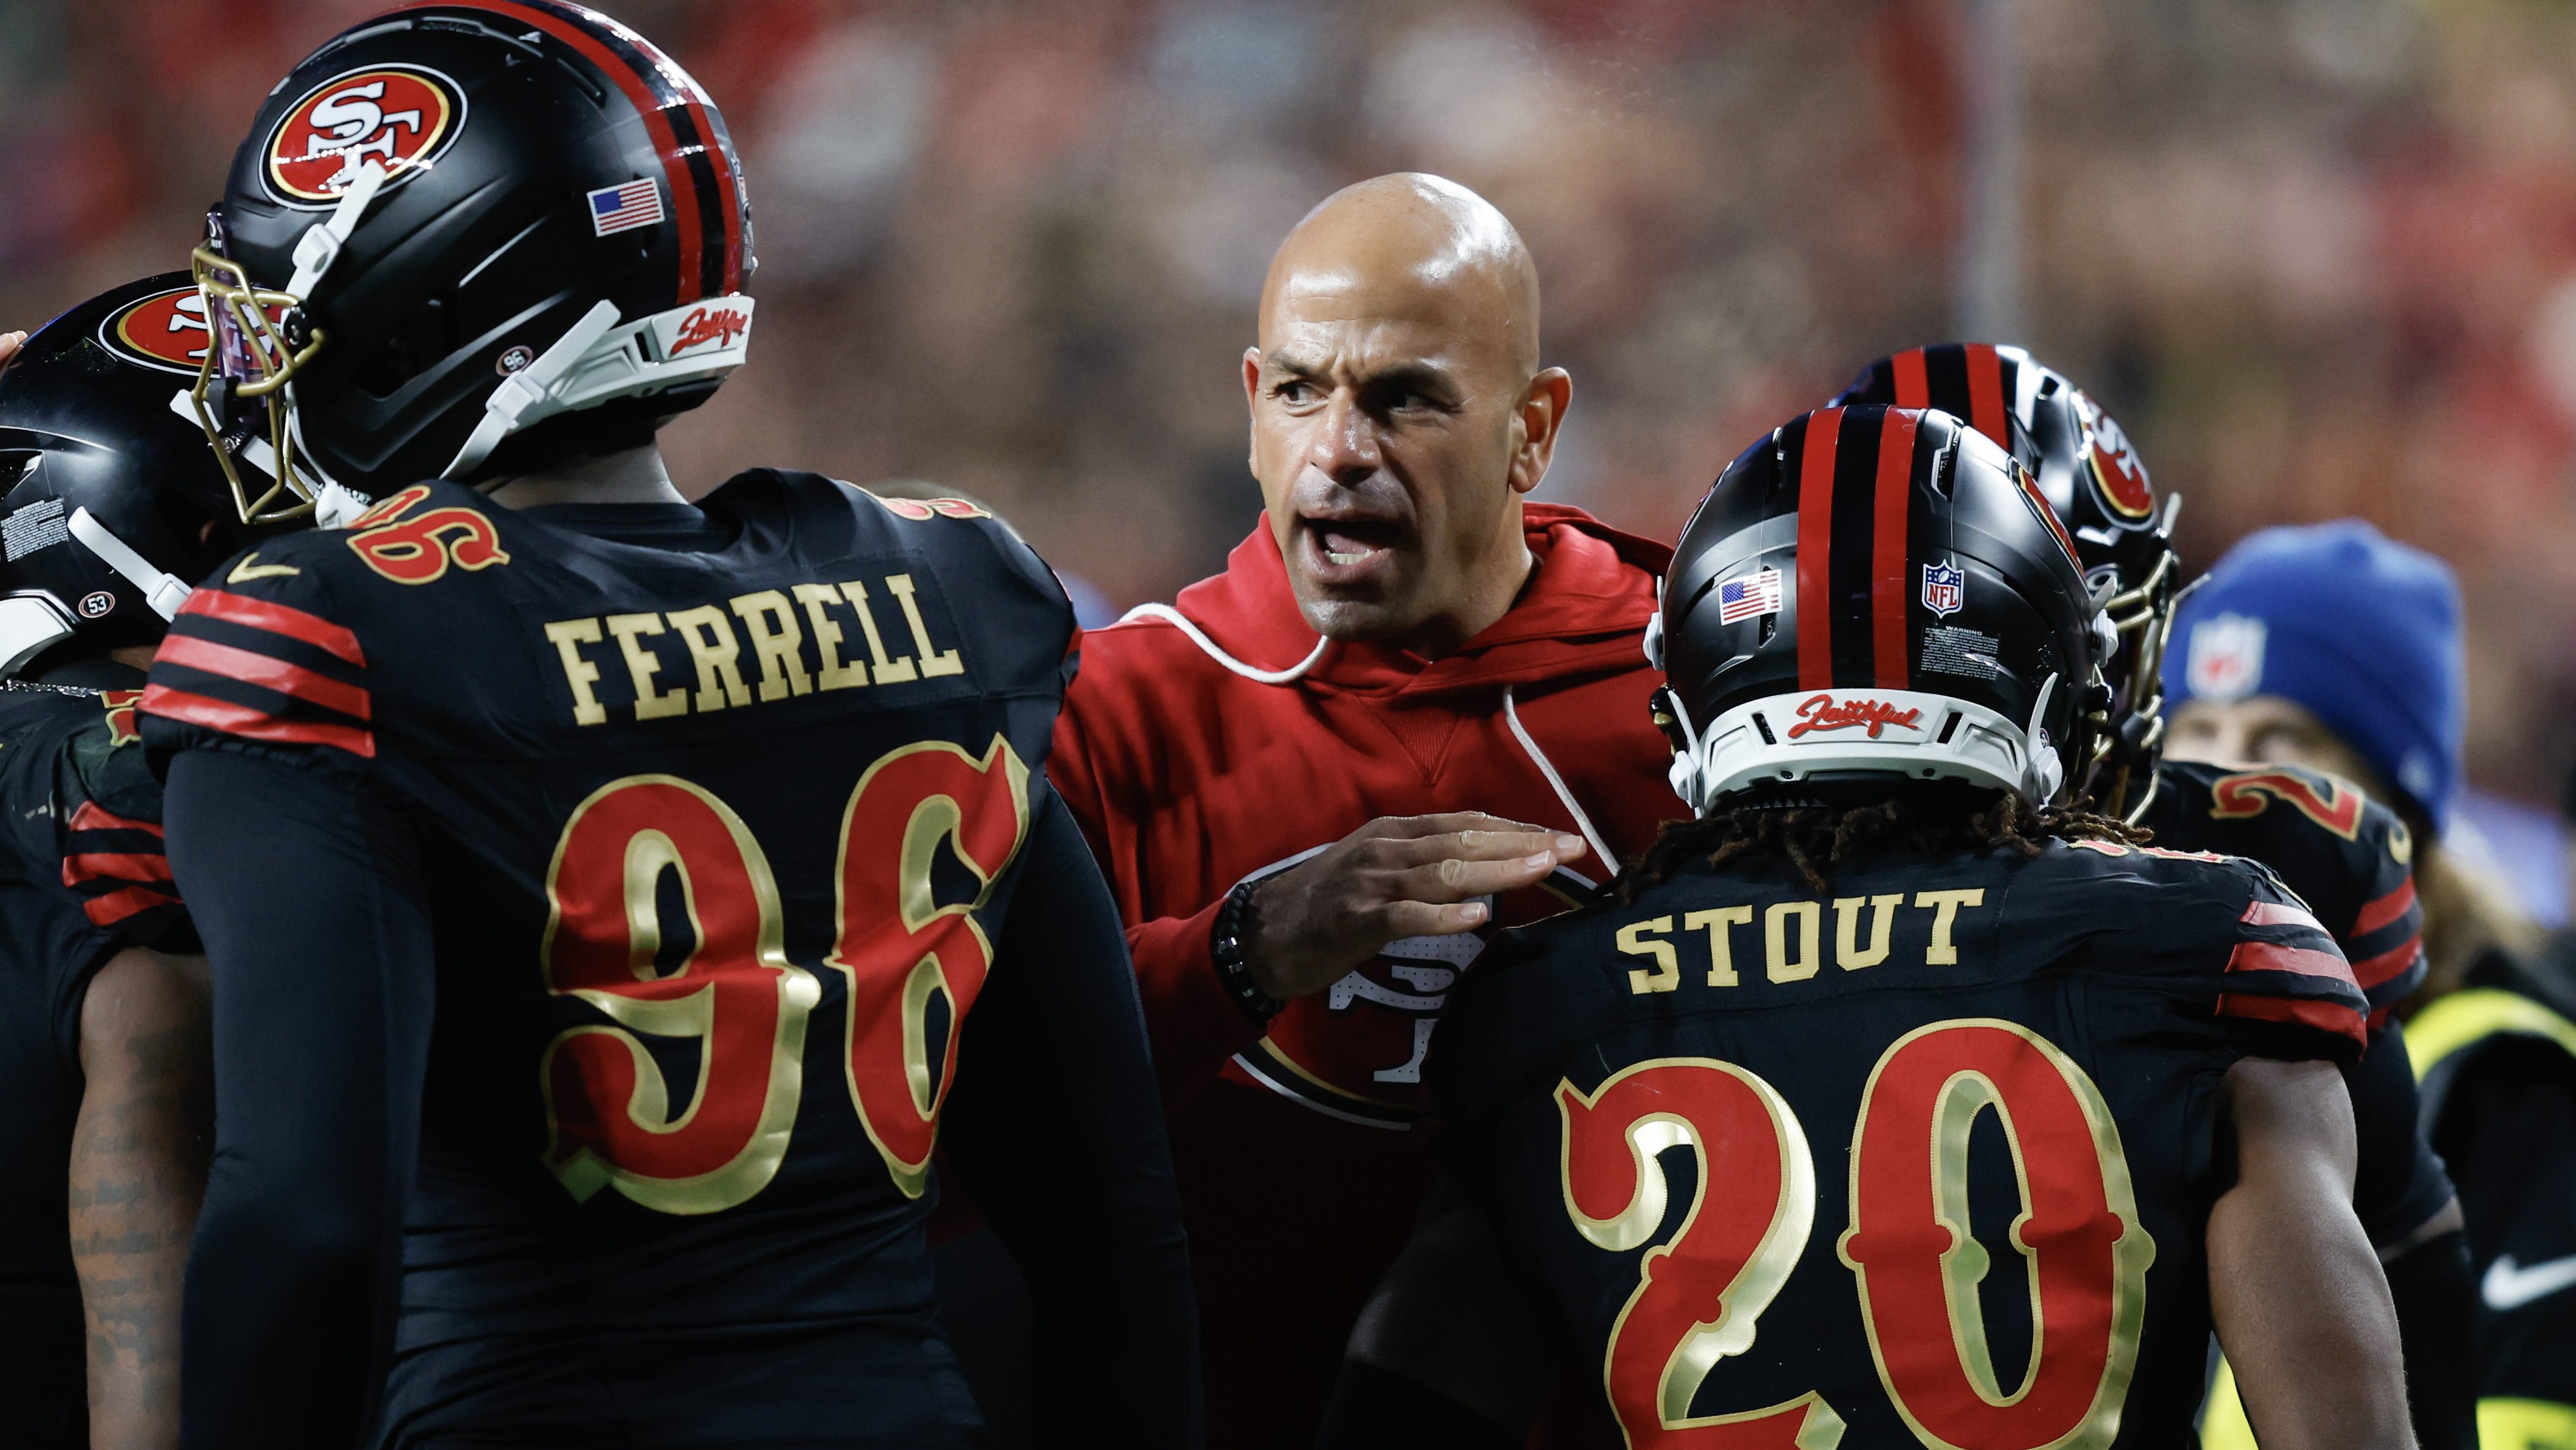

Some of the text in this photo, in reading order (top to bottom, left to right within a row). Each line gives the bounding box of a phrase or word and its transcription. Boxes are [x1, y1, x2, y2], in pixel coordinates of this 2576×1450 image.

[503, 350, 526, 372] 96
[13, 499, 45, 515] WARNING
[87, 595, 106, 614] 53
[1927, 583, 1958, 608] NFL
[1945, 626, 1983, 636] WARNING
[545, 573, 964, 726] FERRELL
[1616, 888, 1985, 994] STOUT
[540, 731, 1031, 1216] 96
[1552, 1017, 2157, 1450] 20
